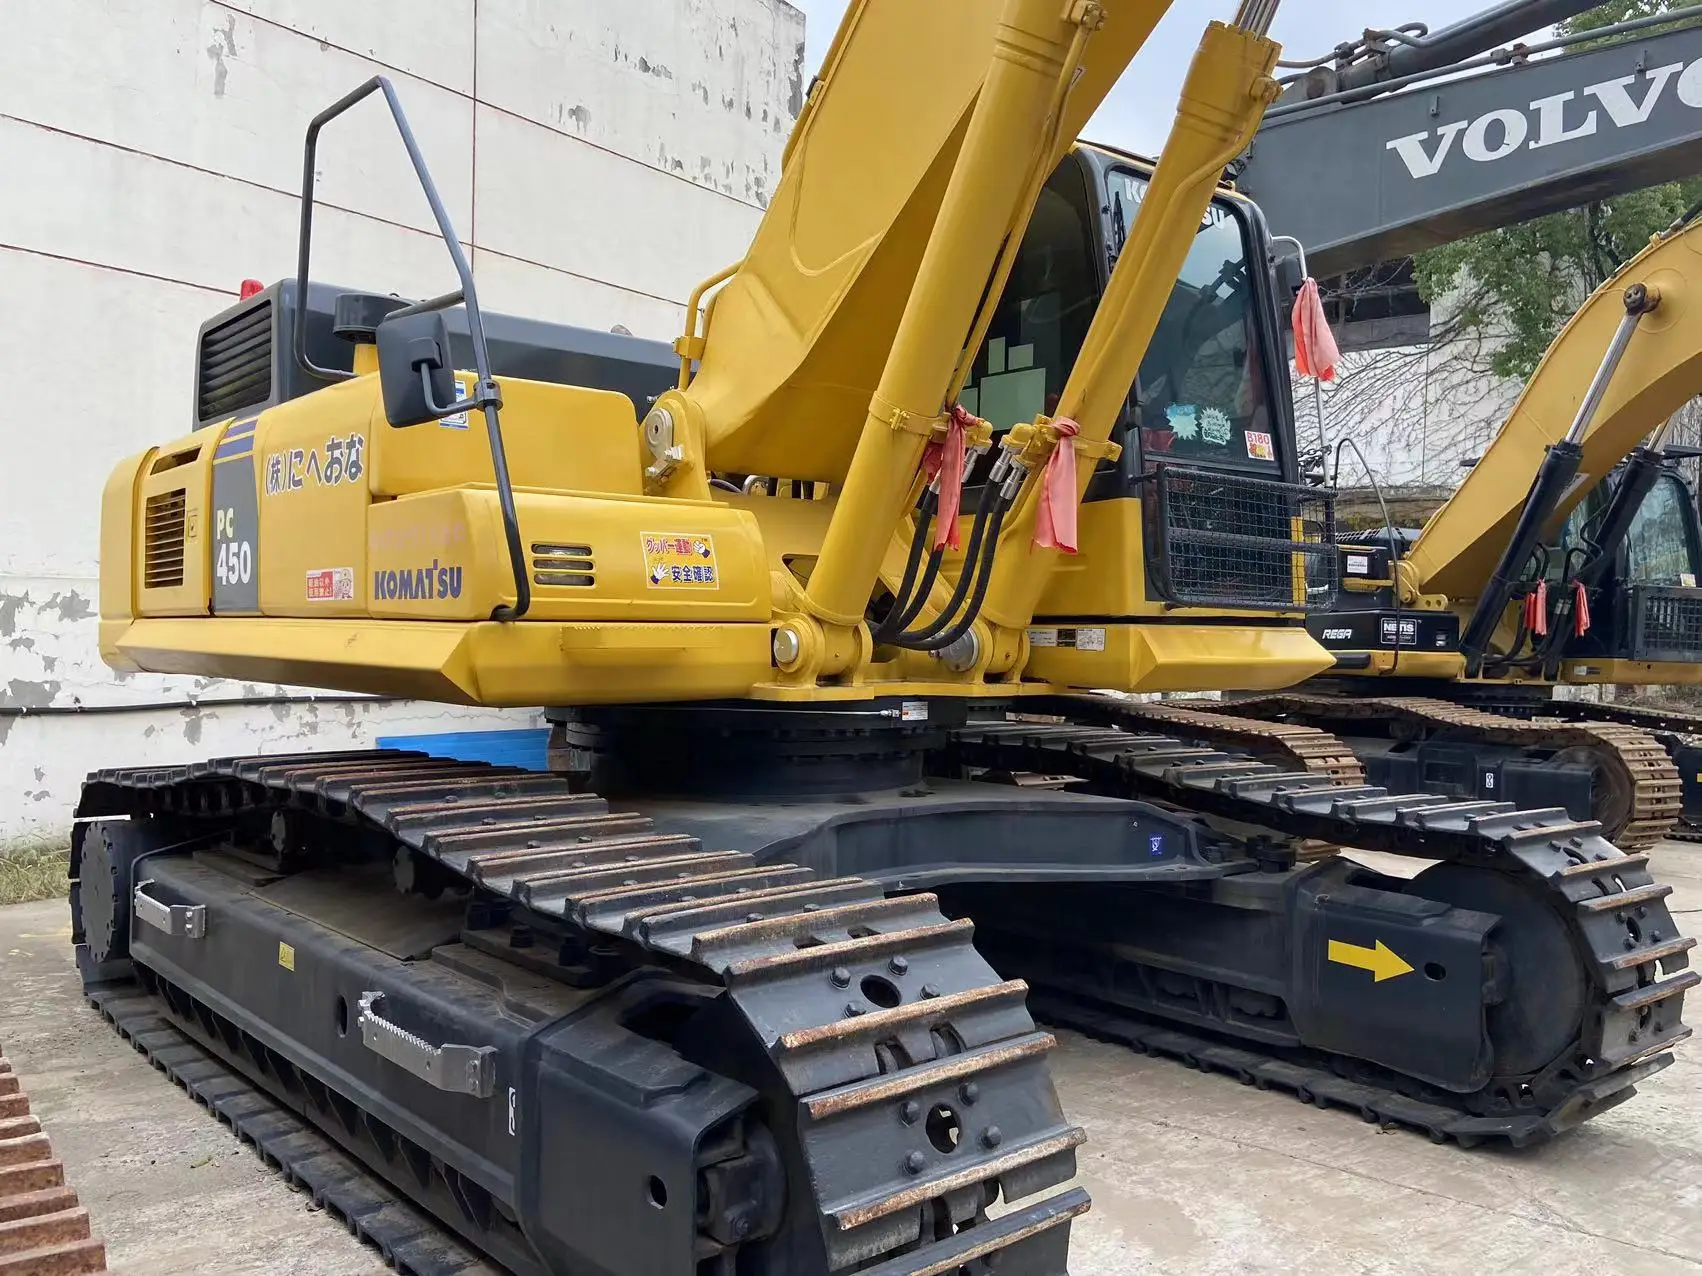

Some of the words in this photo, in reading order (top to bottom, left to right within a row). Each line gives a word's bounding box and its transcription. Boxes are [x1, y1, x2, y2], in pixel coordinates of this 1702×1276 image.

[1246, 432, 1270, 445] B180
[216, 508, 234, 539] PC
[216, 541, 252, 585] 450
[671, 565, 715, 583] 安全確認
[374, 559, 462, 600] KOMATSU
[1322, 628, 1352, 640] REGA
